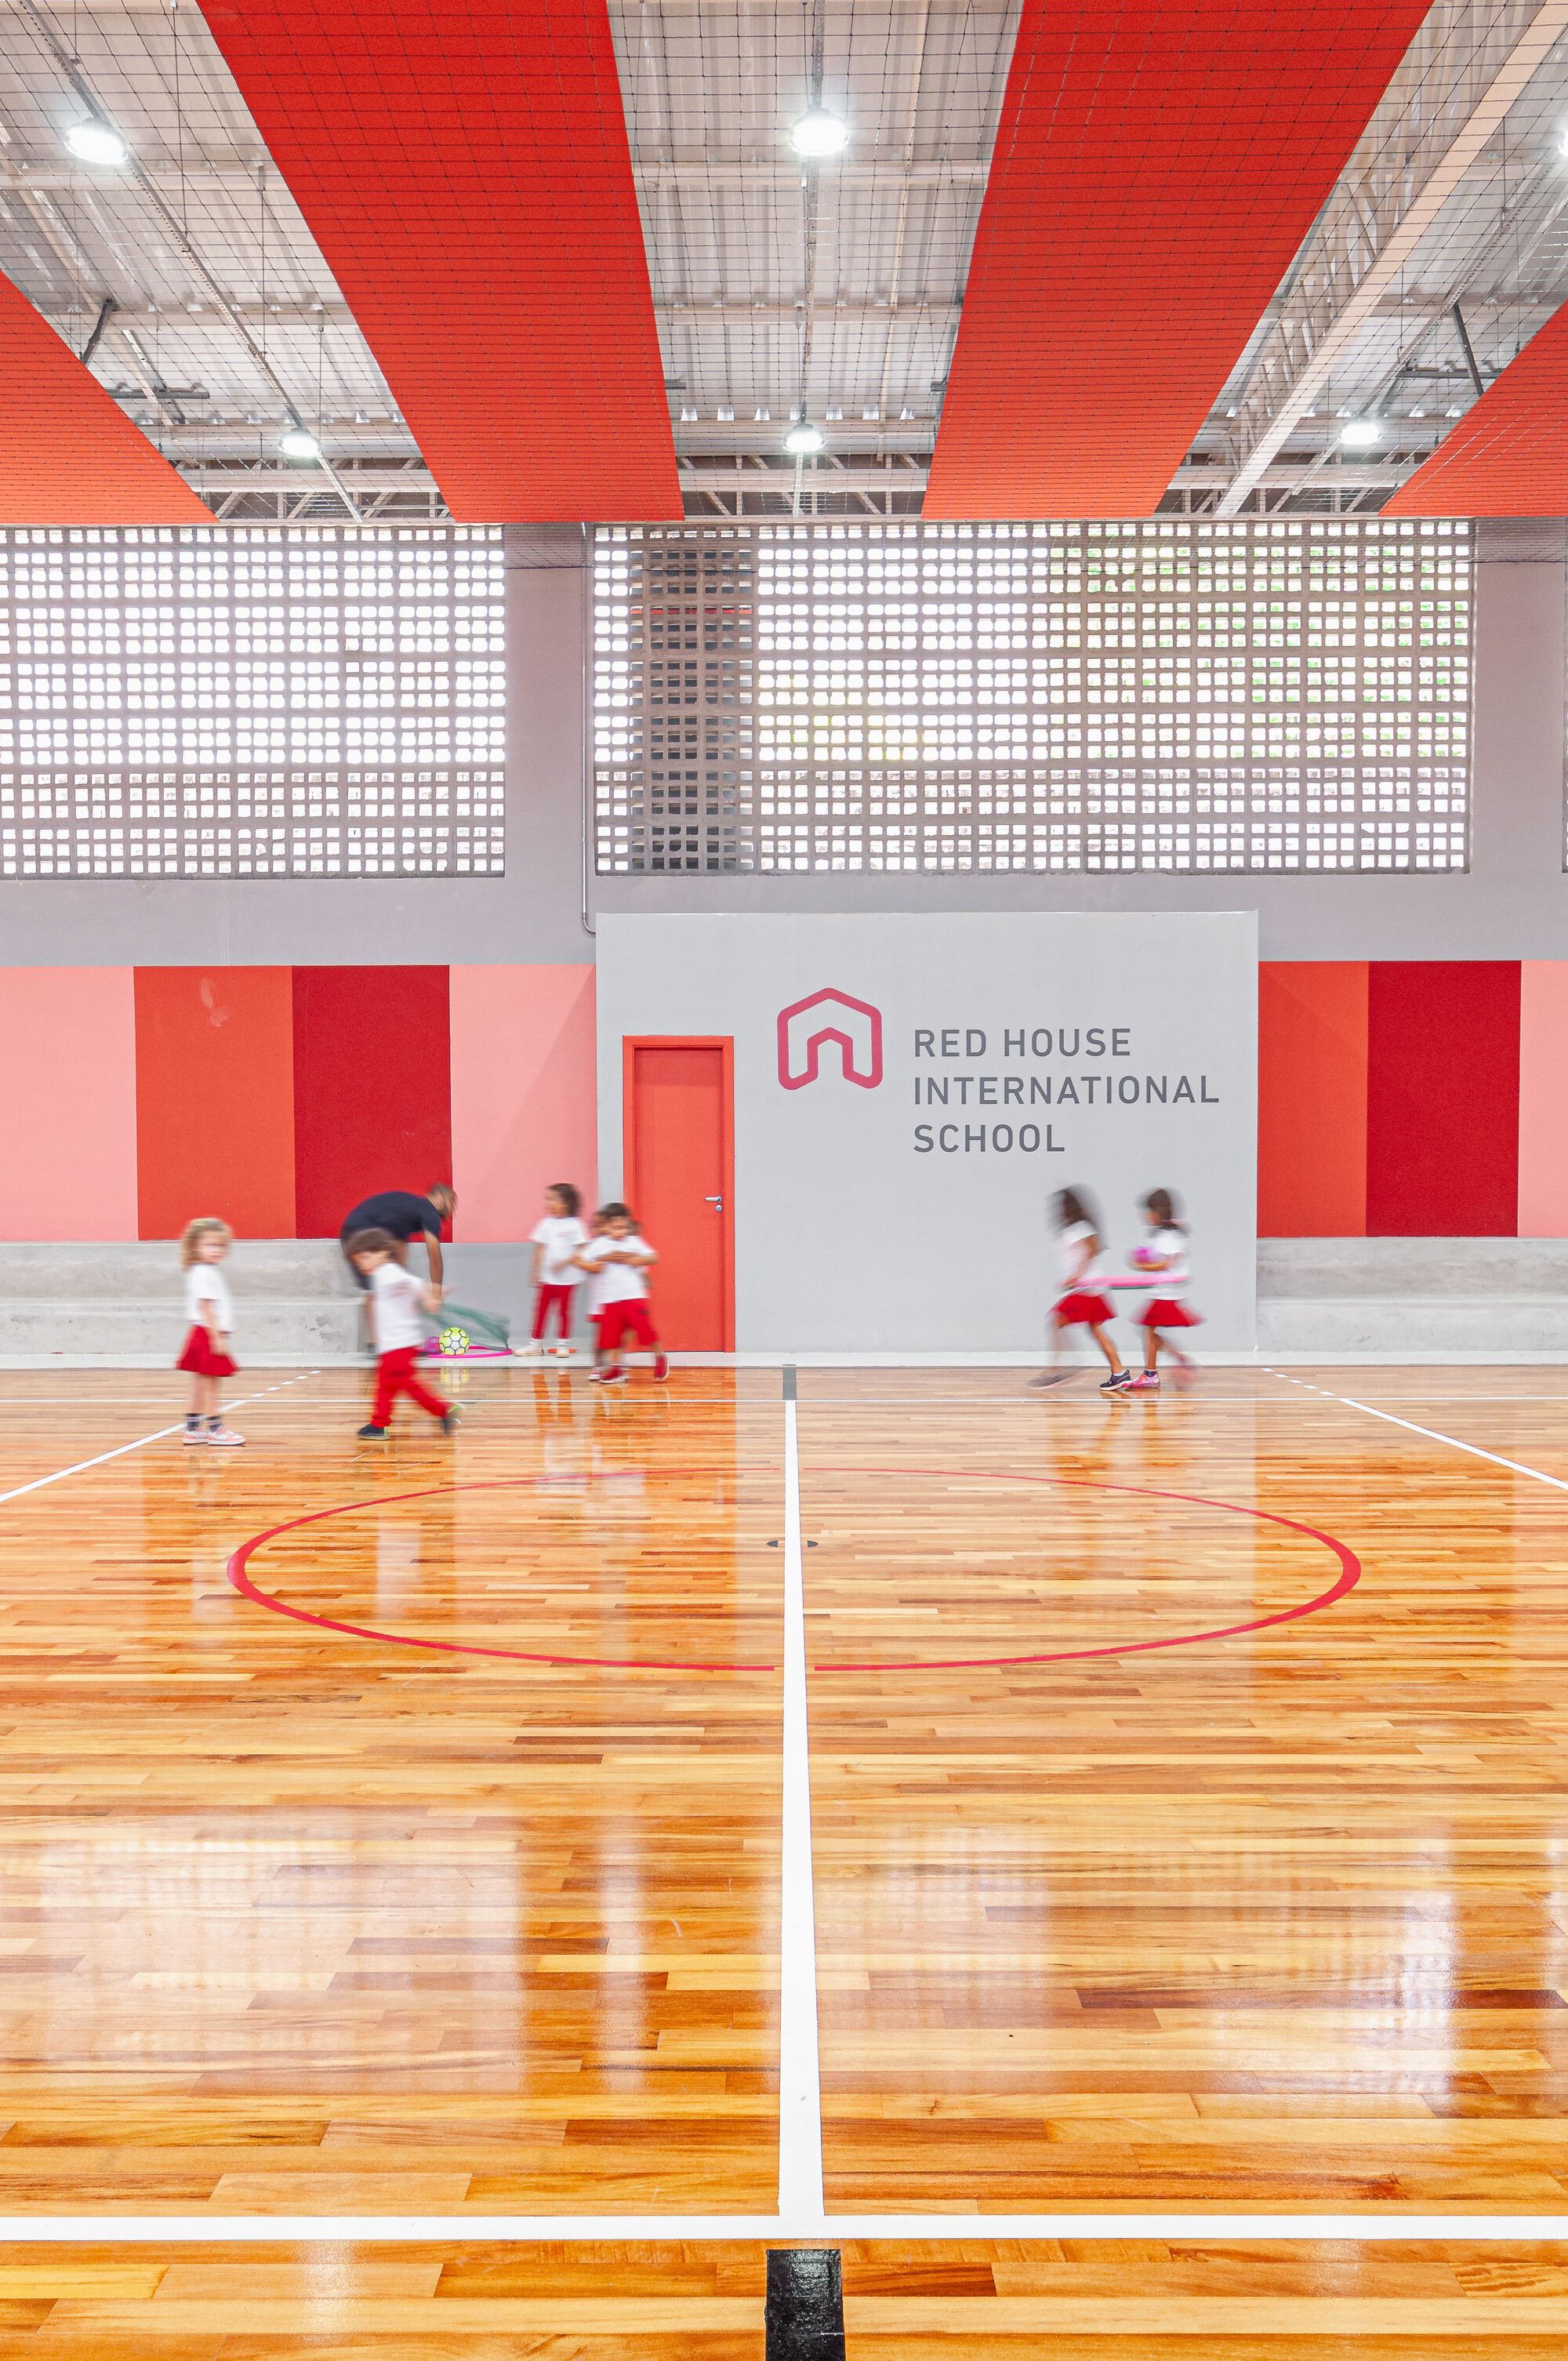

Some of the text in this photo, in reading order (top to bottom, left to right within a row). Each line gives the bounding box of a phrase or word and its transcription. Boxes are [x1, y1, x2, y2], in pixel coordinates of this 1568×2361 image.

[914, 1027, 1131, 1056] RED HOUSE
[914, 1075, 1219, 1104] INTERNATIONAL
[913, 1124, 1065, 1153] SCHOOL
